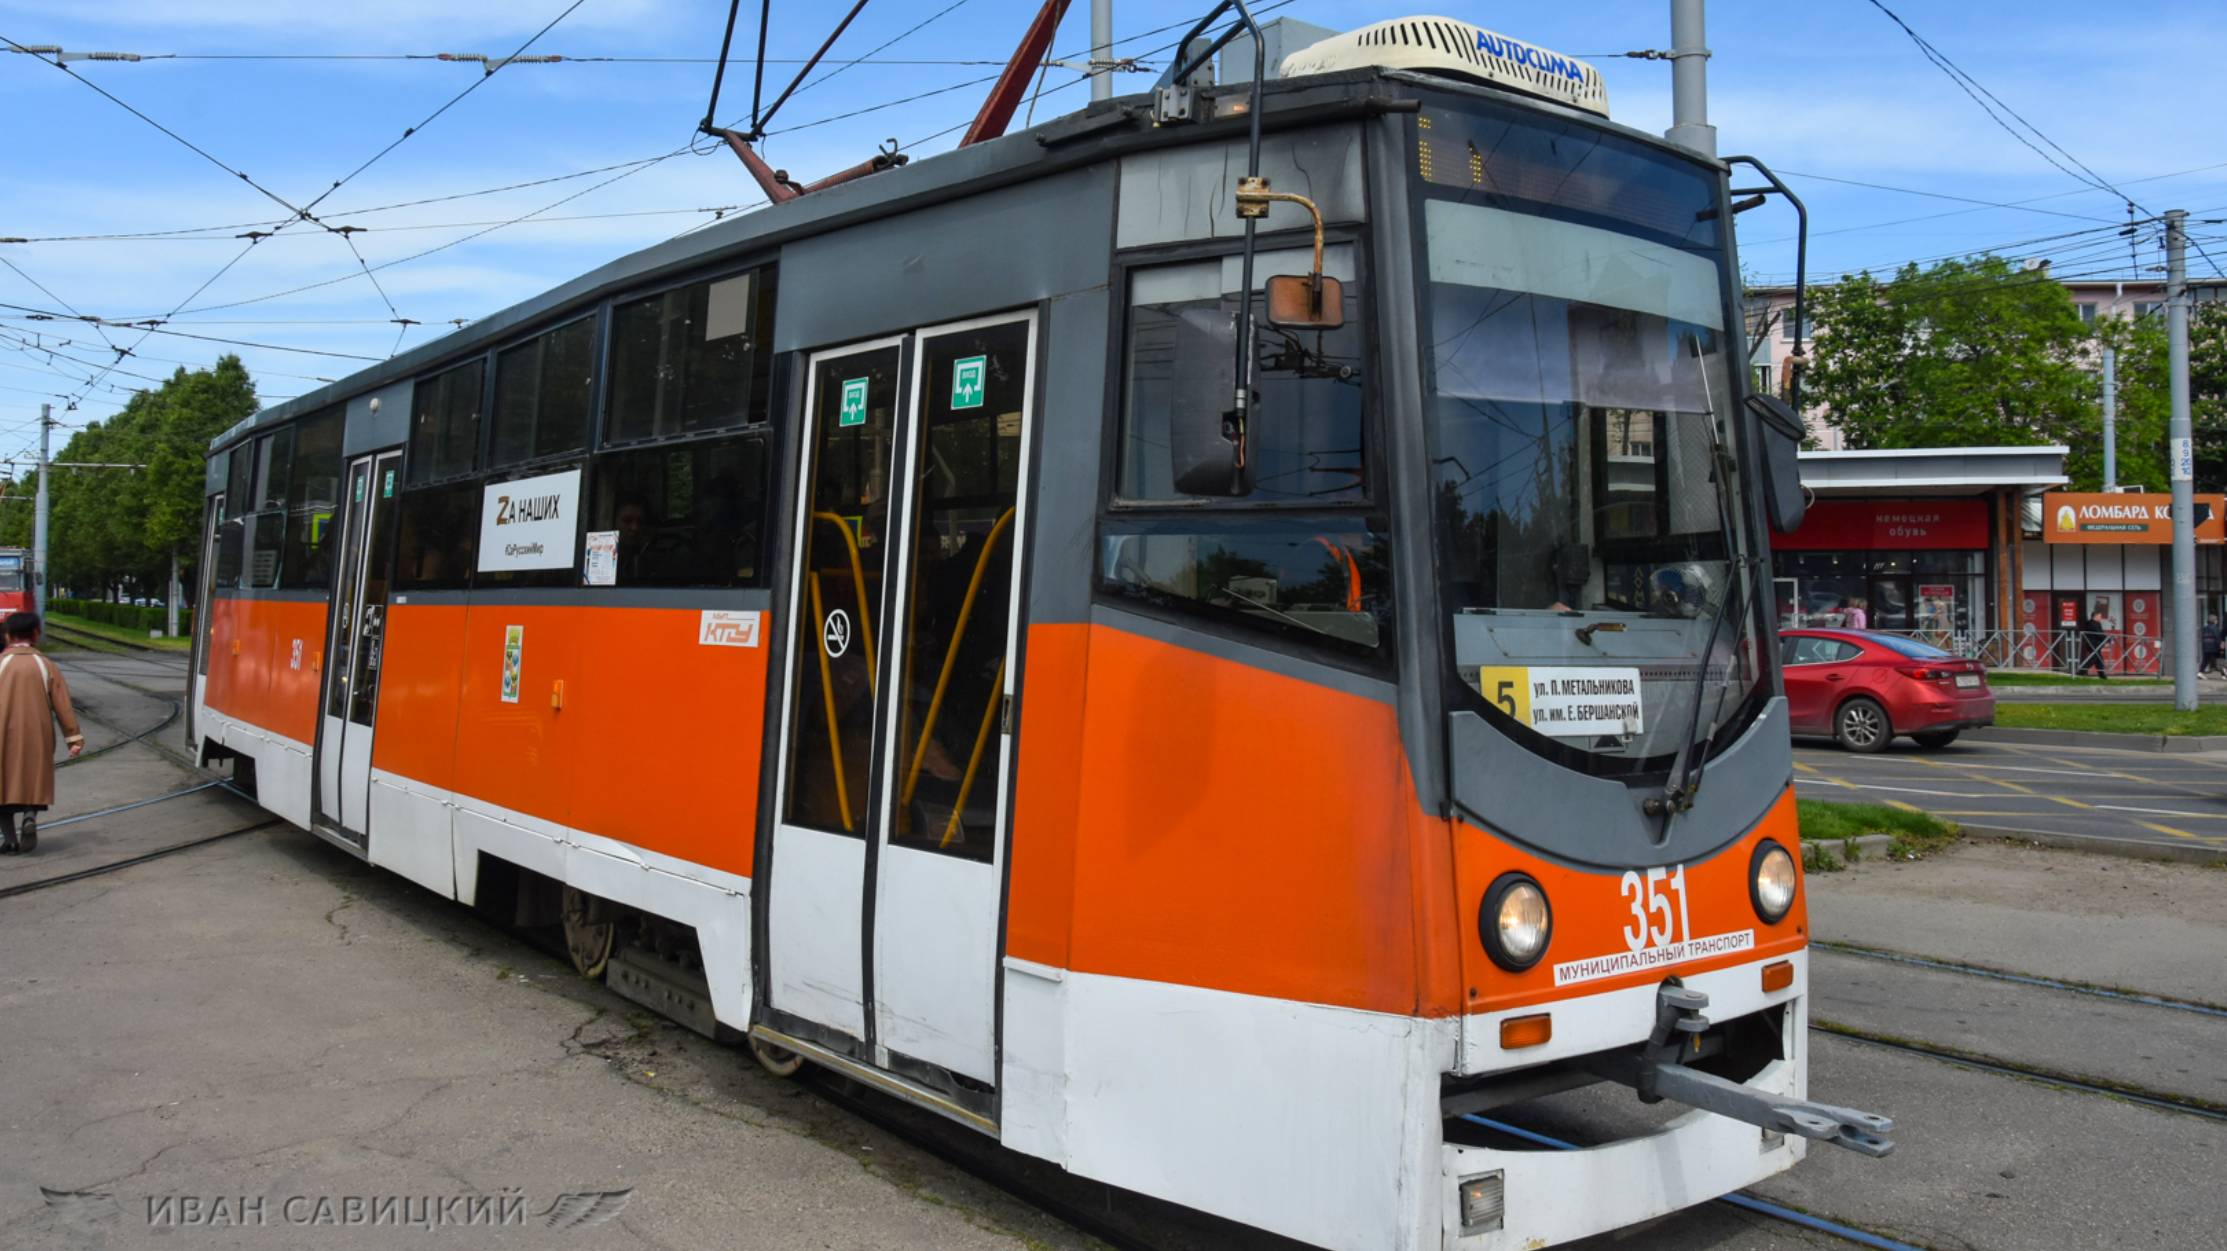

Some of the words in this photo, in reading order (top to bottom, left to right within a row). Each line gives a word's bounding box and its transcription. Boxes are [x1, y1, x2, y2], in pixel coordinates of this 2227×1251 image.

[1476, 30, 1584, 83] AUTOCLIMA
[518, 494, 560, 522] НАШИХ
[2079, 504, 2149, 519] ЛОМБАРД
[1888, 525, 1927, 538] обувь
[1497, 681, 1516, 720] 5
[1533, 682, 1549, 698] ул.
[1551, 680, 1561, 696] П.
[1562, 679, 1635, 696] МЕТАЛЬНИКОВА
[1533, 708, 1548, 724] ул.
[1550, 707, 1566, 721] им.
[1568, 705, 1576, 721] Е.
[1577, 701, 1639, 721] БЕРШАНСКОЙ
[1621, 864, 1690, 952] 351
[1559, 944, 1685, 981] МУНИЦИПАЛЬНЫЙ
[1687, 932, 1750, 956] ТРАНСПОРТ
